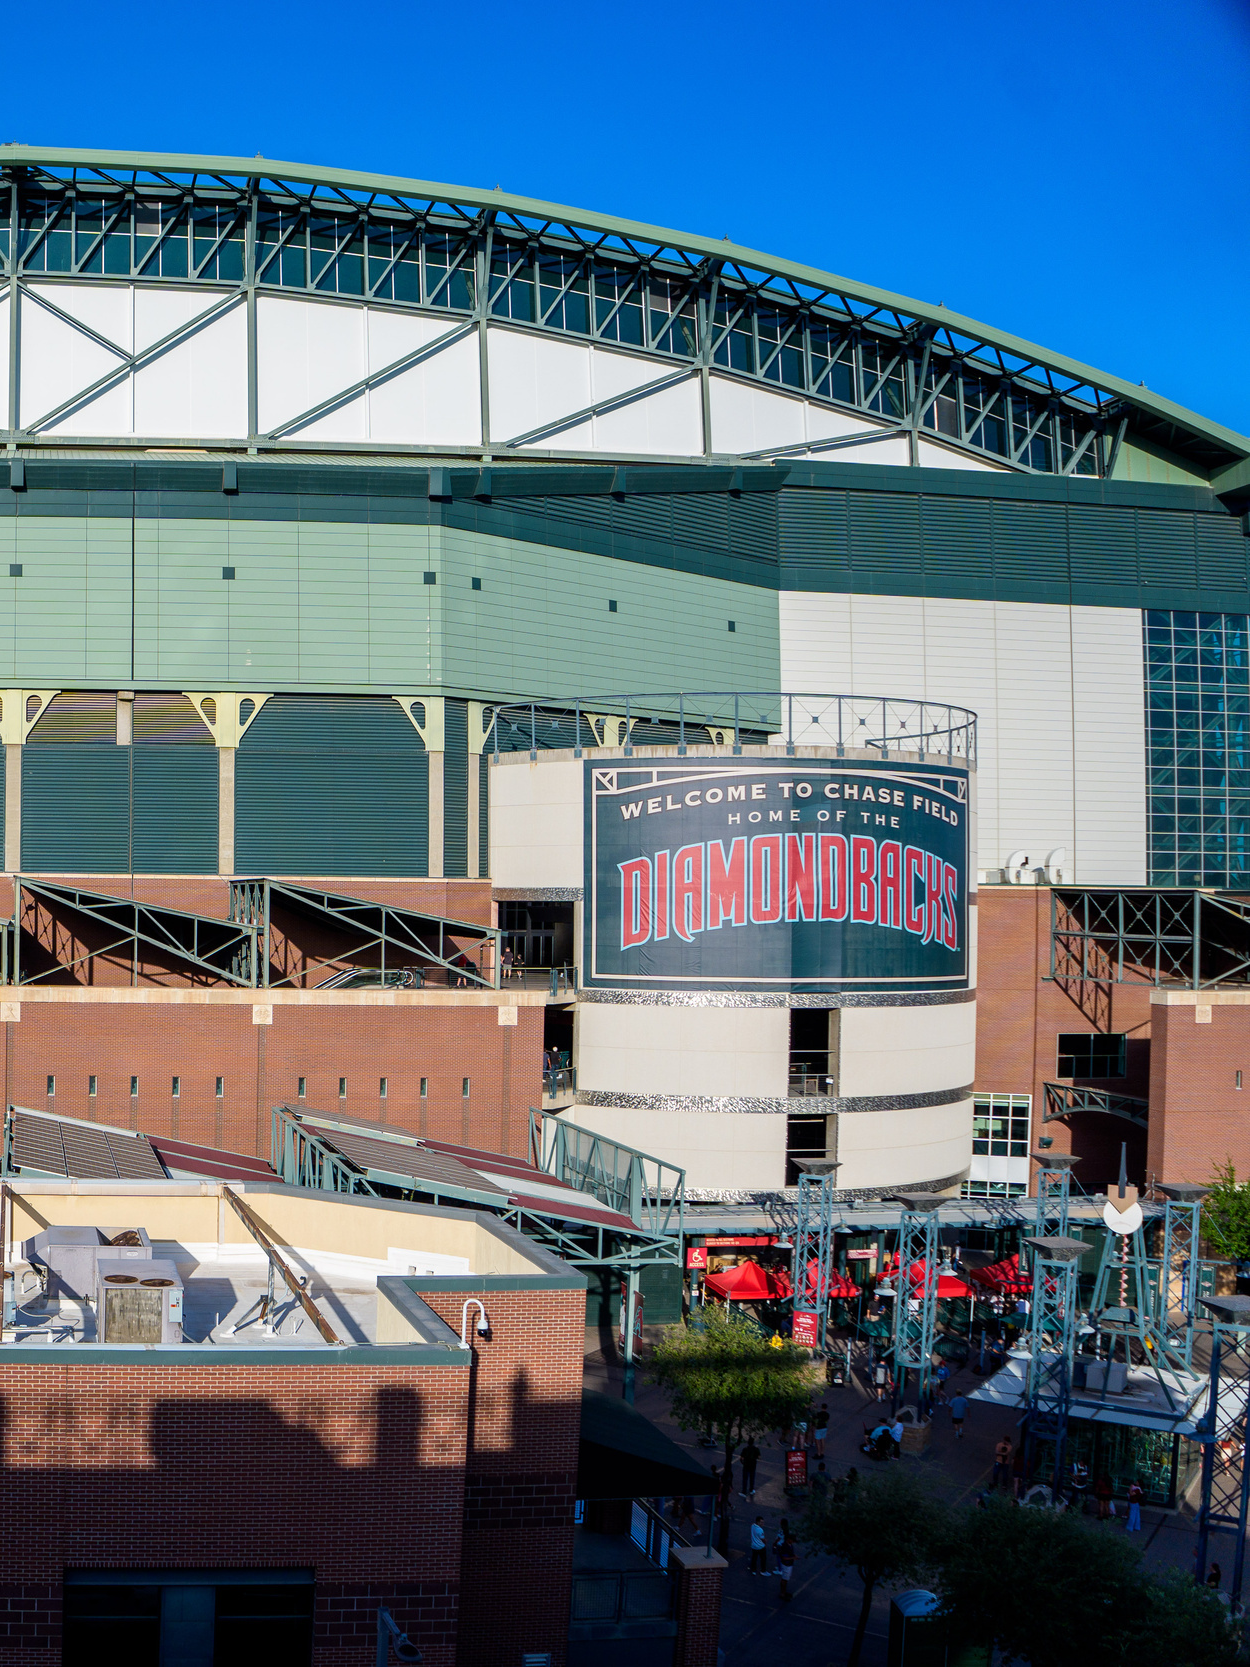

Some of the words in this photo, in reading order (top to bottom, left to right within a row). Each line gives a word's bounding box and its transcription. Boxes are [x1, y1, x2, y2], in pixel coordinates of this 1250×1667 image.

[620, 783, 767, 821] WELCOME
[778, 782, 813, 799] TO
[823, 783, 905, 807] CHASE
[912, 795, 959, 827] FIELD
[728, 809, 801, 825] HOME
[817, 810, 847, 823] OF
[860, 812, 900, 829] THE
[616, 832, 959, 952] DIAMONDBACKS
